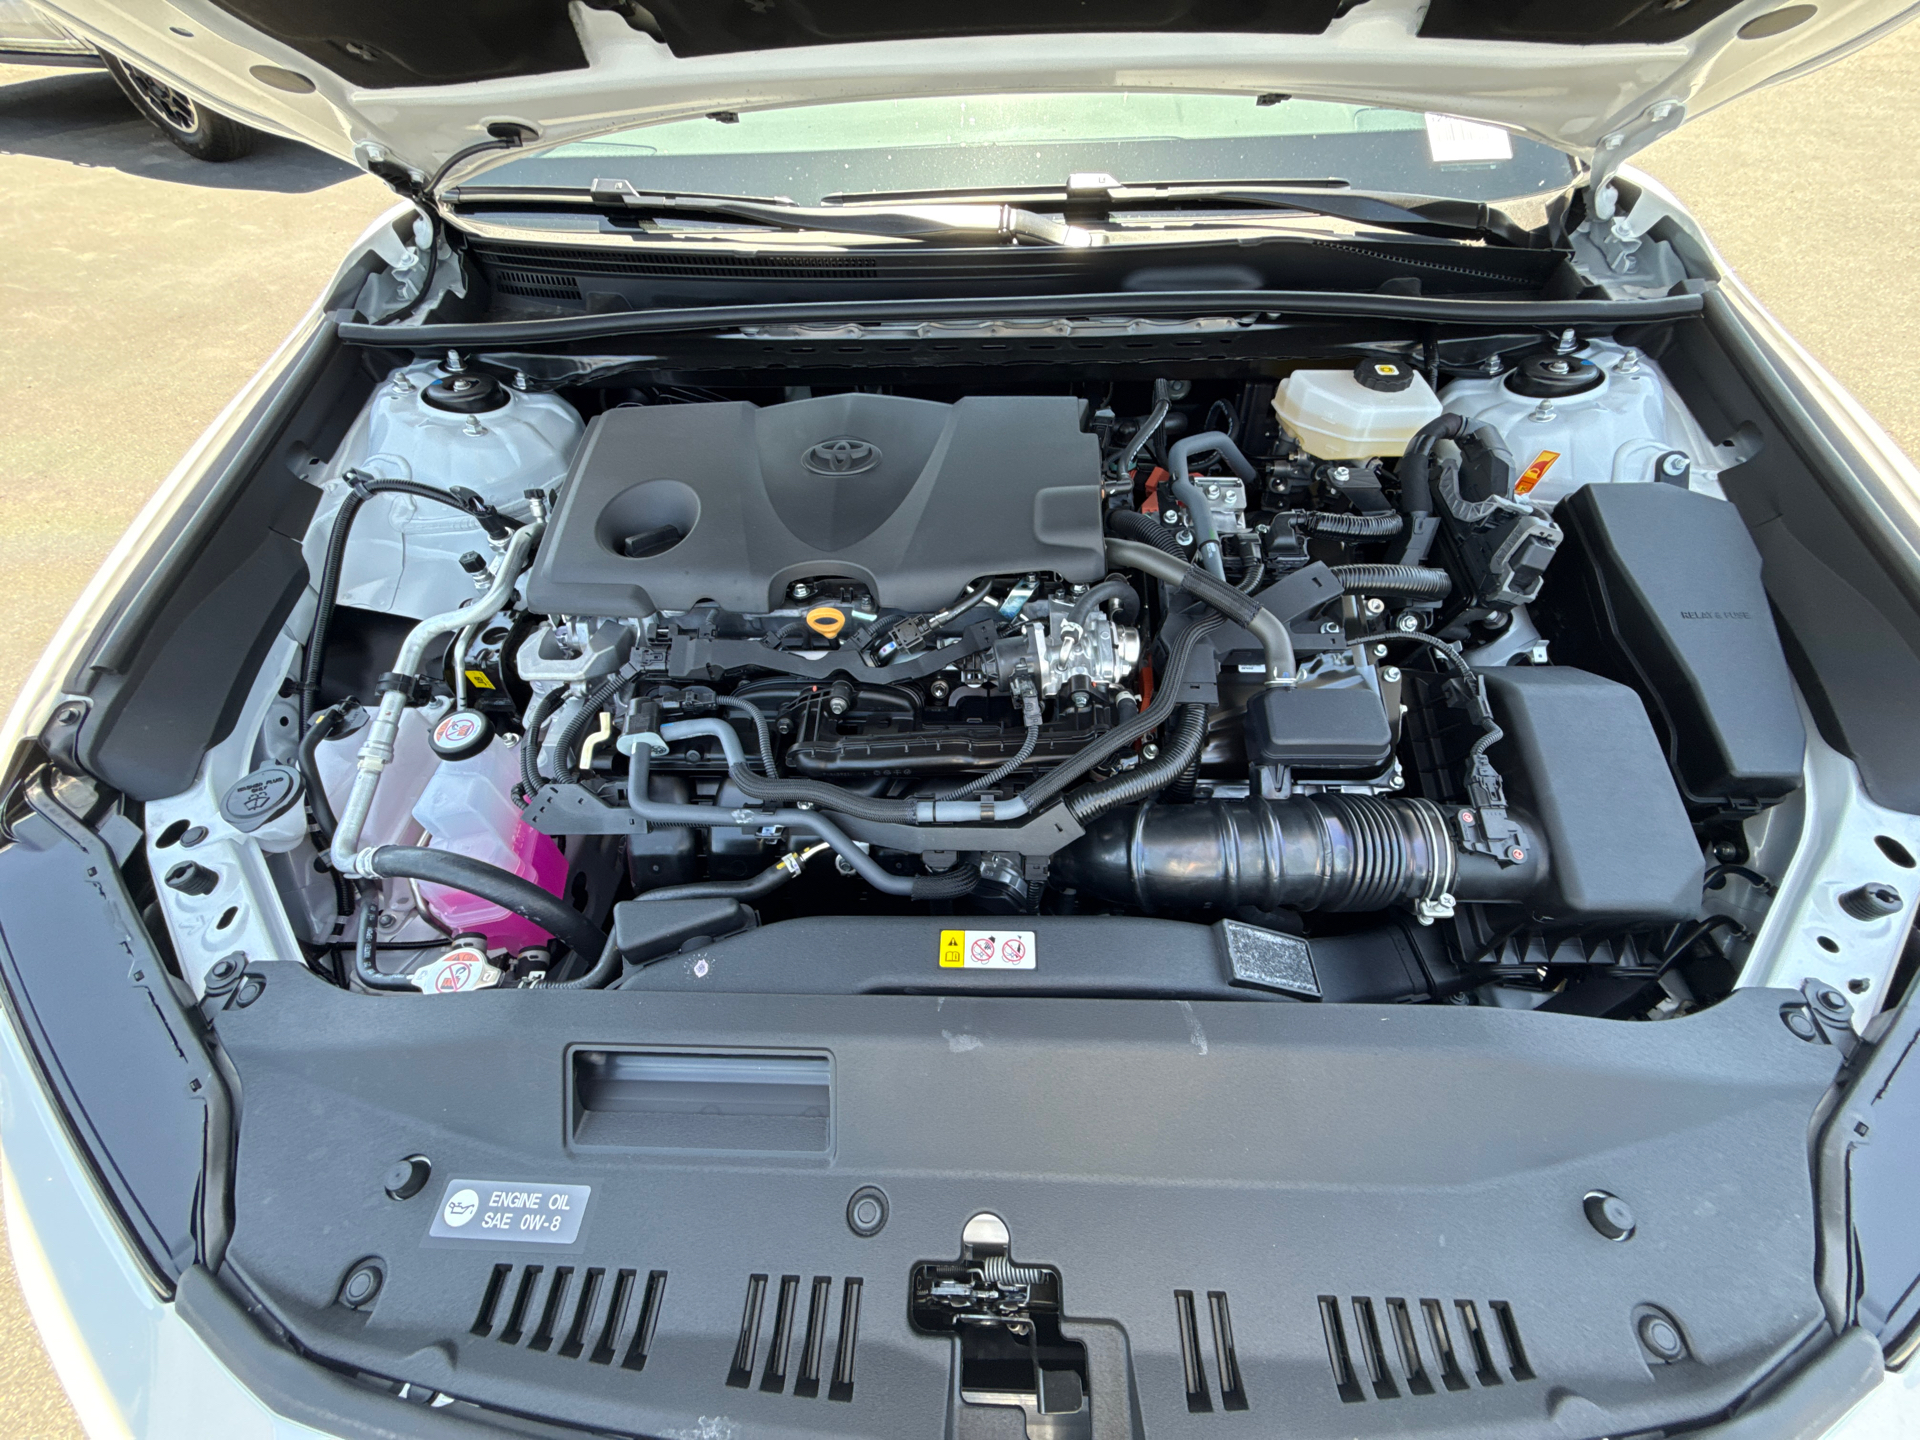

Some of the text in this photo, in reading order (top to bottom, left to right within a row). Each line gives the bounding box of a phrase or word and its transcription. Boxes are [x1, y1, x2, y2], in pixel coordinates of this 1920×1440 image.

[1680, 611, 1713, 620] RELAY
[1723, 611, 1752, 620] FUSE
[489, 1191, 570, 1211] ENGINE OIL
[481, 1211, 561, 1232] SAE 0W-8
